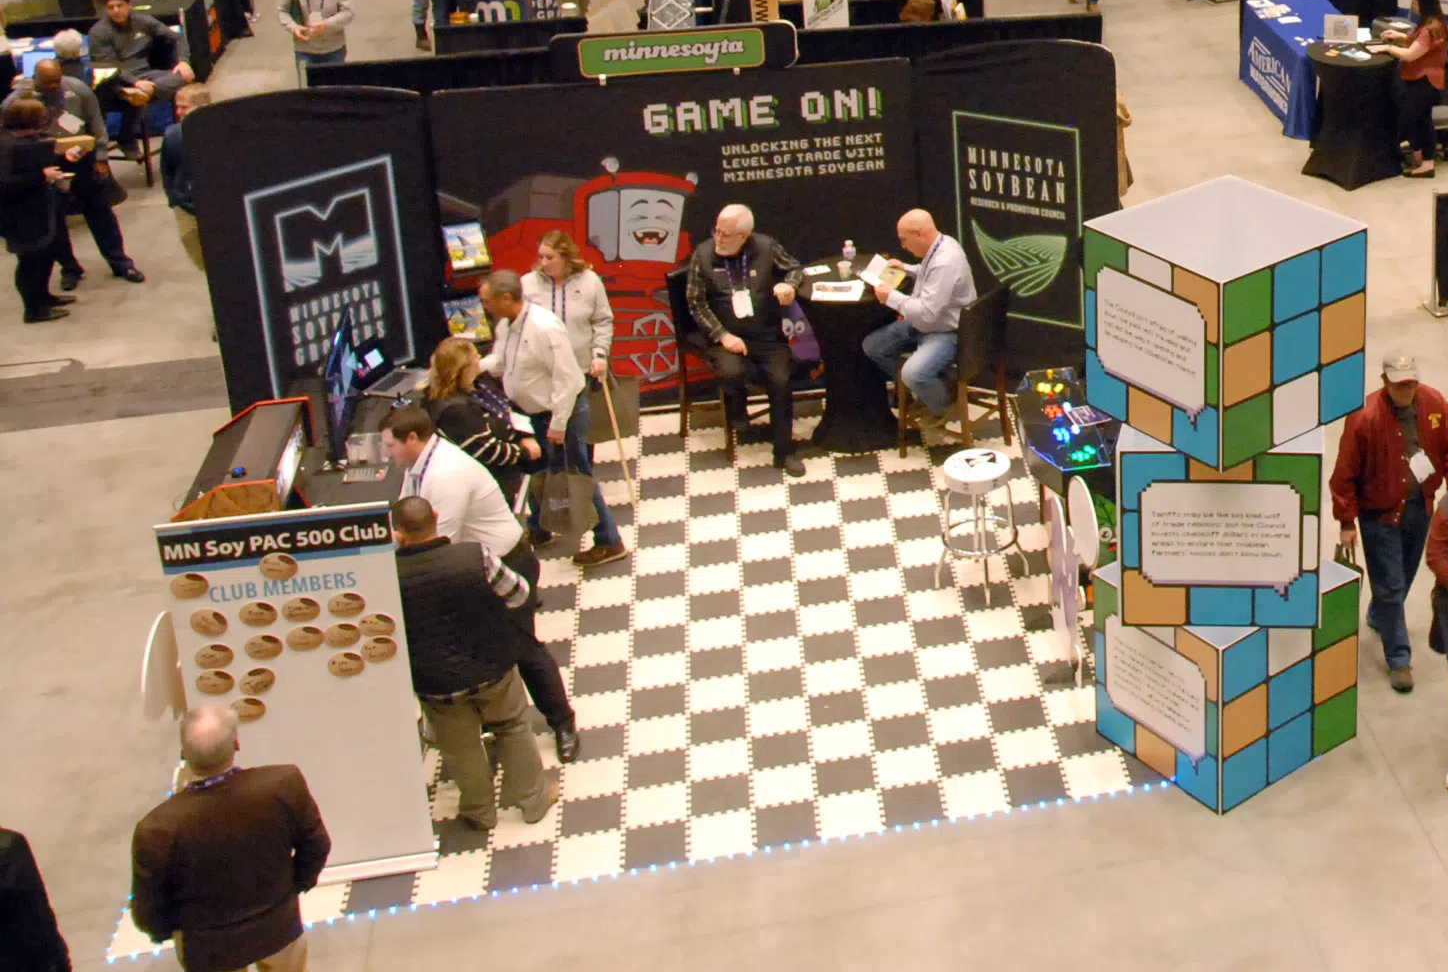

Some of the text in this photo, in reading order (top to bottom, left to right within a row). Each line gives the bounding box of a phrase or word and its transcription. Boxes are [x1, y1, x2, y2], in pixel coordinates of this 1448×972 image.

[604, 39, 744, 64] minnesoyta
[643, 87, 882, 136] GAME ON!
[722, 133, 883, 156] UNLOCKING THE NEXT
[722, 146, 884, 169] LEVEL OF TRADE WITH
[723, 159, 885, 183] MINNESOTA SOYBEAN
[967, 146, 1065, 178] MINNESOTA
[968, 168, 1065, 204] SOYBEAN
[295, 320, 385, 366] GROERS
[163, 523, 388, 561] MN Soy PAC 500 Club
[209, 571, 358, 604] CLUB MEMBERS
